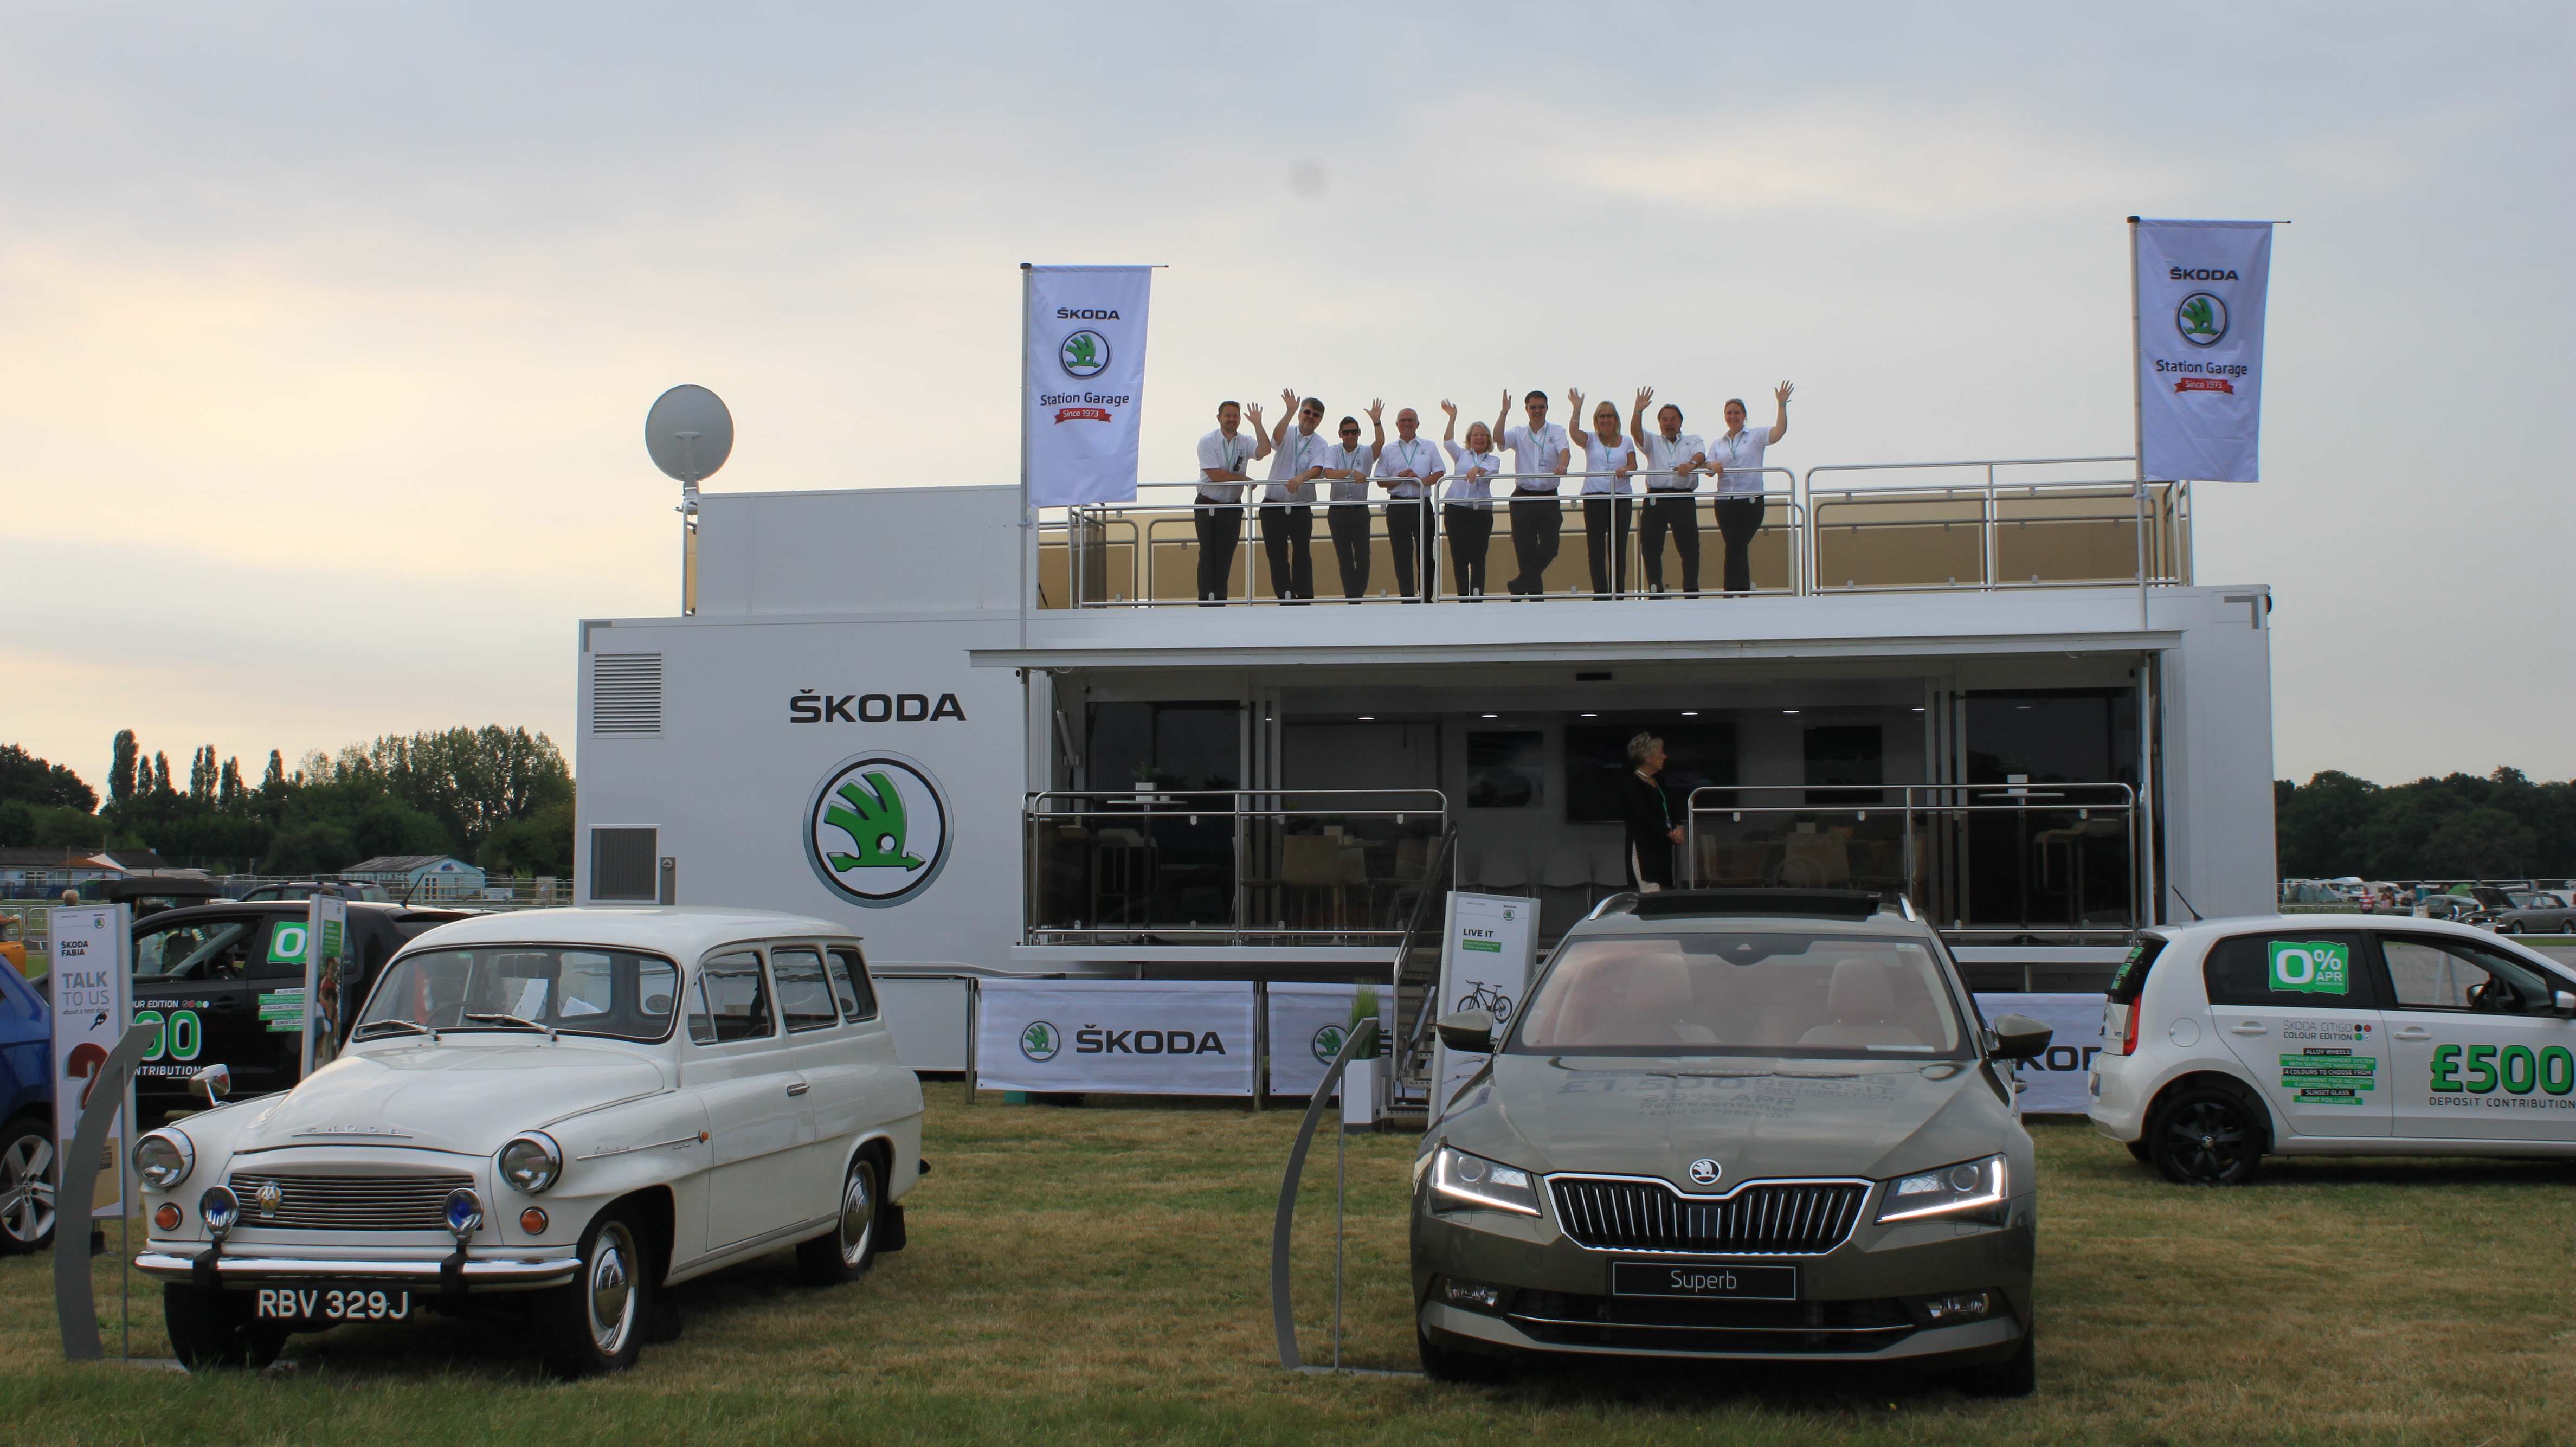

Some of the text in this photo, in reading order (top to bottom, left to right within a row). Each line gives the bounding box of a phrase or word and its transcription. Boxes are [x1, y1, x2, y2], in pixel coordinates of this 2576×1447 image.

[2169, 266, 2238, 281] ŠKODA
[1057, 307, 1120, 320] ŠKODA
[2156, 359, 2247, 378] Station Garage
[2185, 380, 2205, 388] Since
[1040, 392, 1129, 407] Station Garage
[790, 689, 967, 723] ŠKODA
[1463, 928, 1483, 937] LIVE
[61, 940, 89, 949] ŠKODA
[62, 971, 108, 989] TALK
[2316, 971, 2342, 981] APR
[63, 990, 110, 1006] TO US
[147, 1000, 179, 1008] EDITION
[2284, 1019, 2352, 1032] ŠKODA CITIGO
[1076, 1024, 1226, 1055] ŠKODA
[2283, 1031, 2316, 1039] COLOUR
[2430, 1044, 2574, 1096] £500
[1731, 1094, 1796, 1105] APR
[2429, 1097, 2576, 1109] DEPOSIT CONTRIBUTION
[1671, 1270, 1736, 1293] Superb
[258, 1289, 408, 1319] RBV 329J
